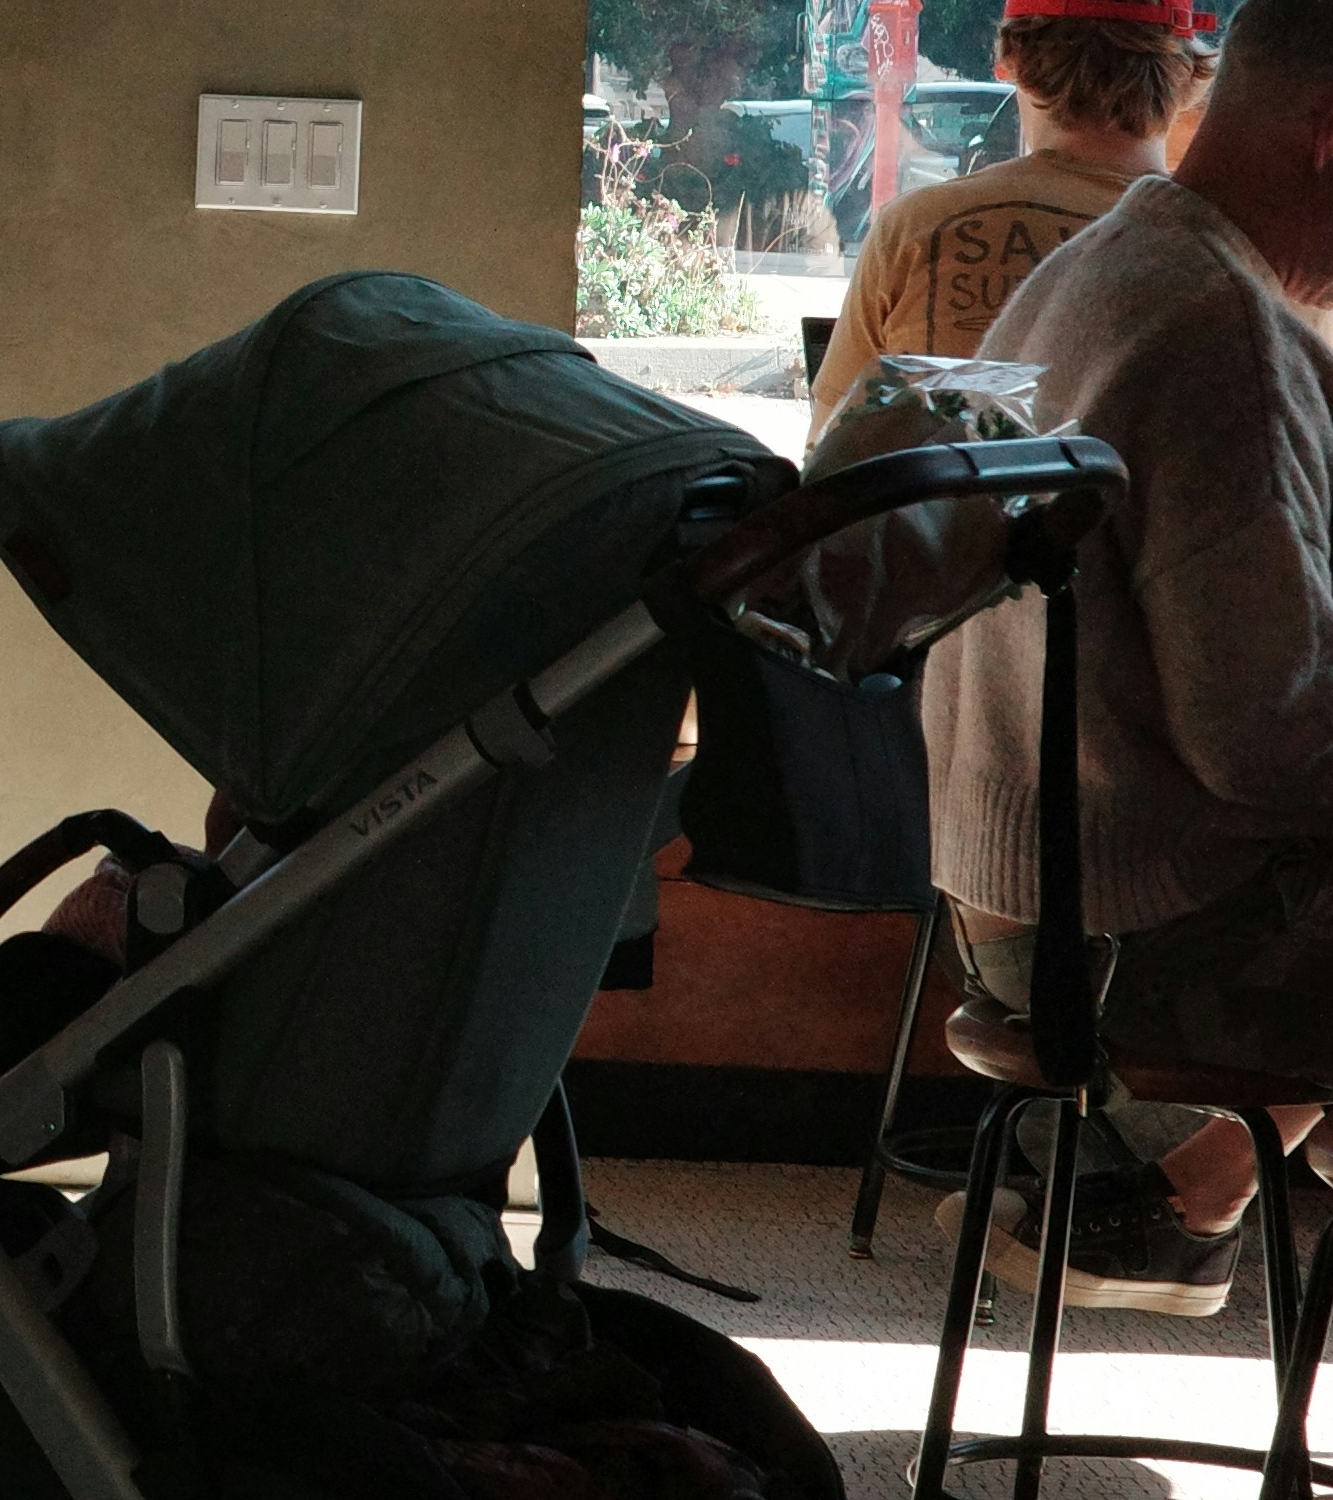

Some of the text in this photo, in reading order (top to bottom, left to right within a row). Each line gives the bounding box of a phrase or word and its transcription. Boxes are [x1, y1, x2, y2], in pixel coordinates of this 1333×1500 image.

[954, 219, 1072, 265] SA
[948, 273, 1027, 312] SU
[349, 769, 438, 837] VISTA
